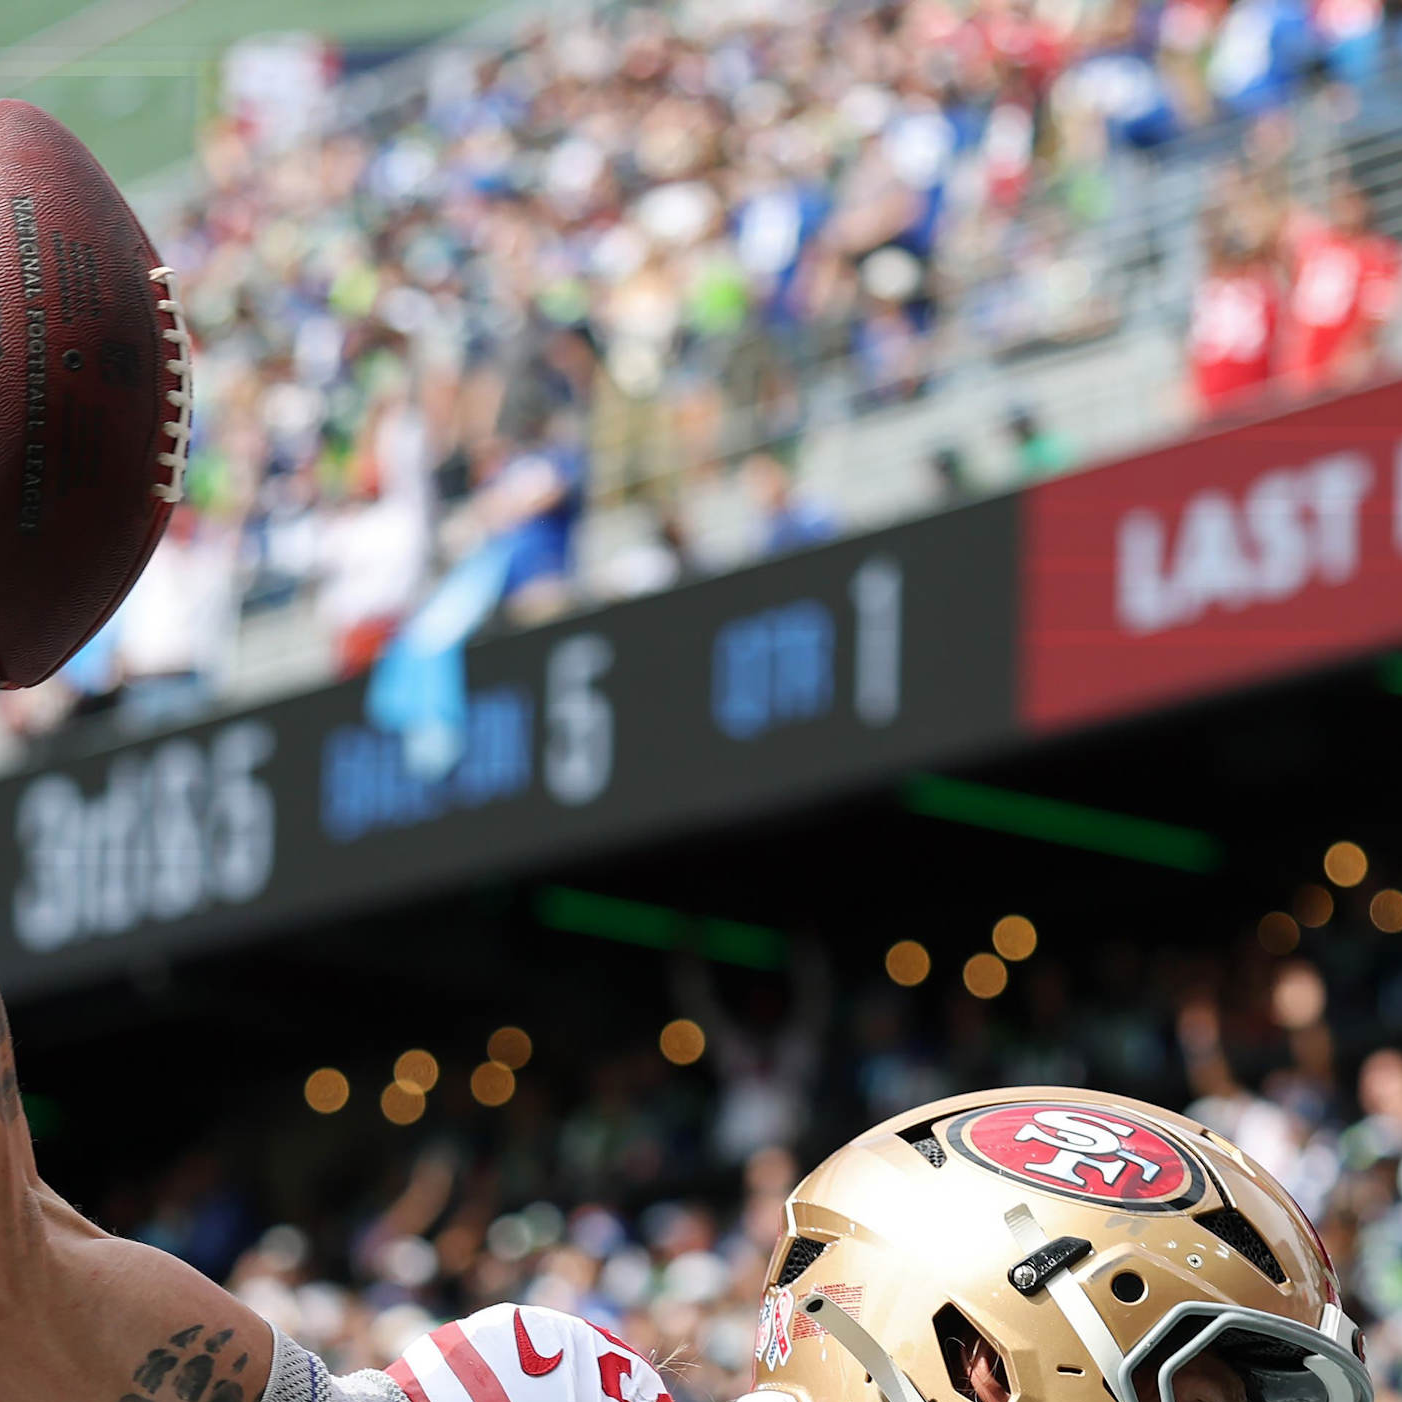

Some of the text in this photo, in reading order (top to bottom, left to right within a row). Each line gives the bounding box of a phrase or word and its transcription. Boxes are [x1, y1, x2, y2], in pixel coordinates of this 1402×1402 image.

[12, 196, 48, 535] NATIONAL FOOTBALL LEAGUE
[1112, 448, 1373, 634] LAST
[543, 631, 614, 808] 5
[850, 553, 904, 730] 1
